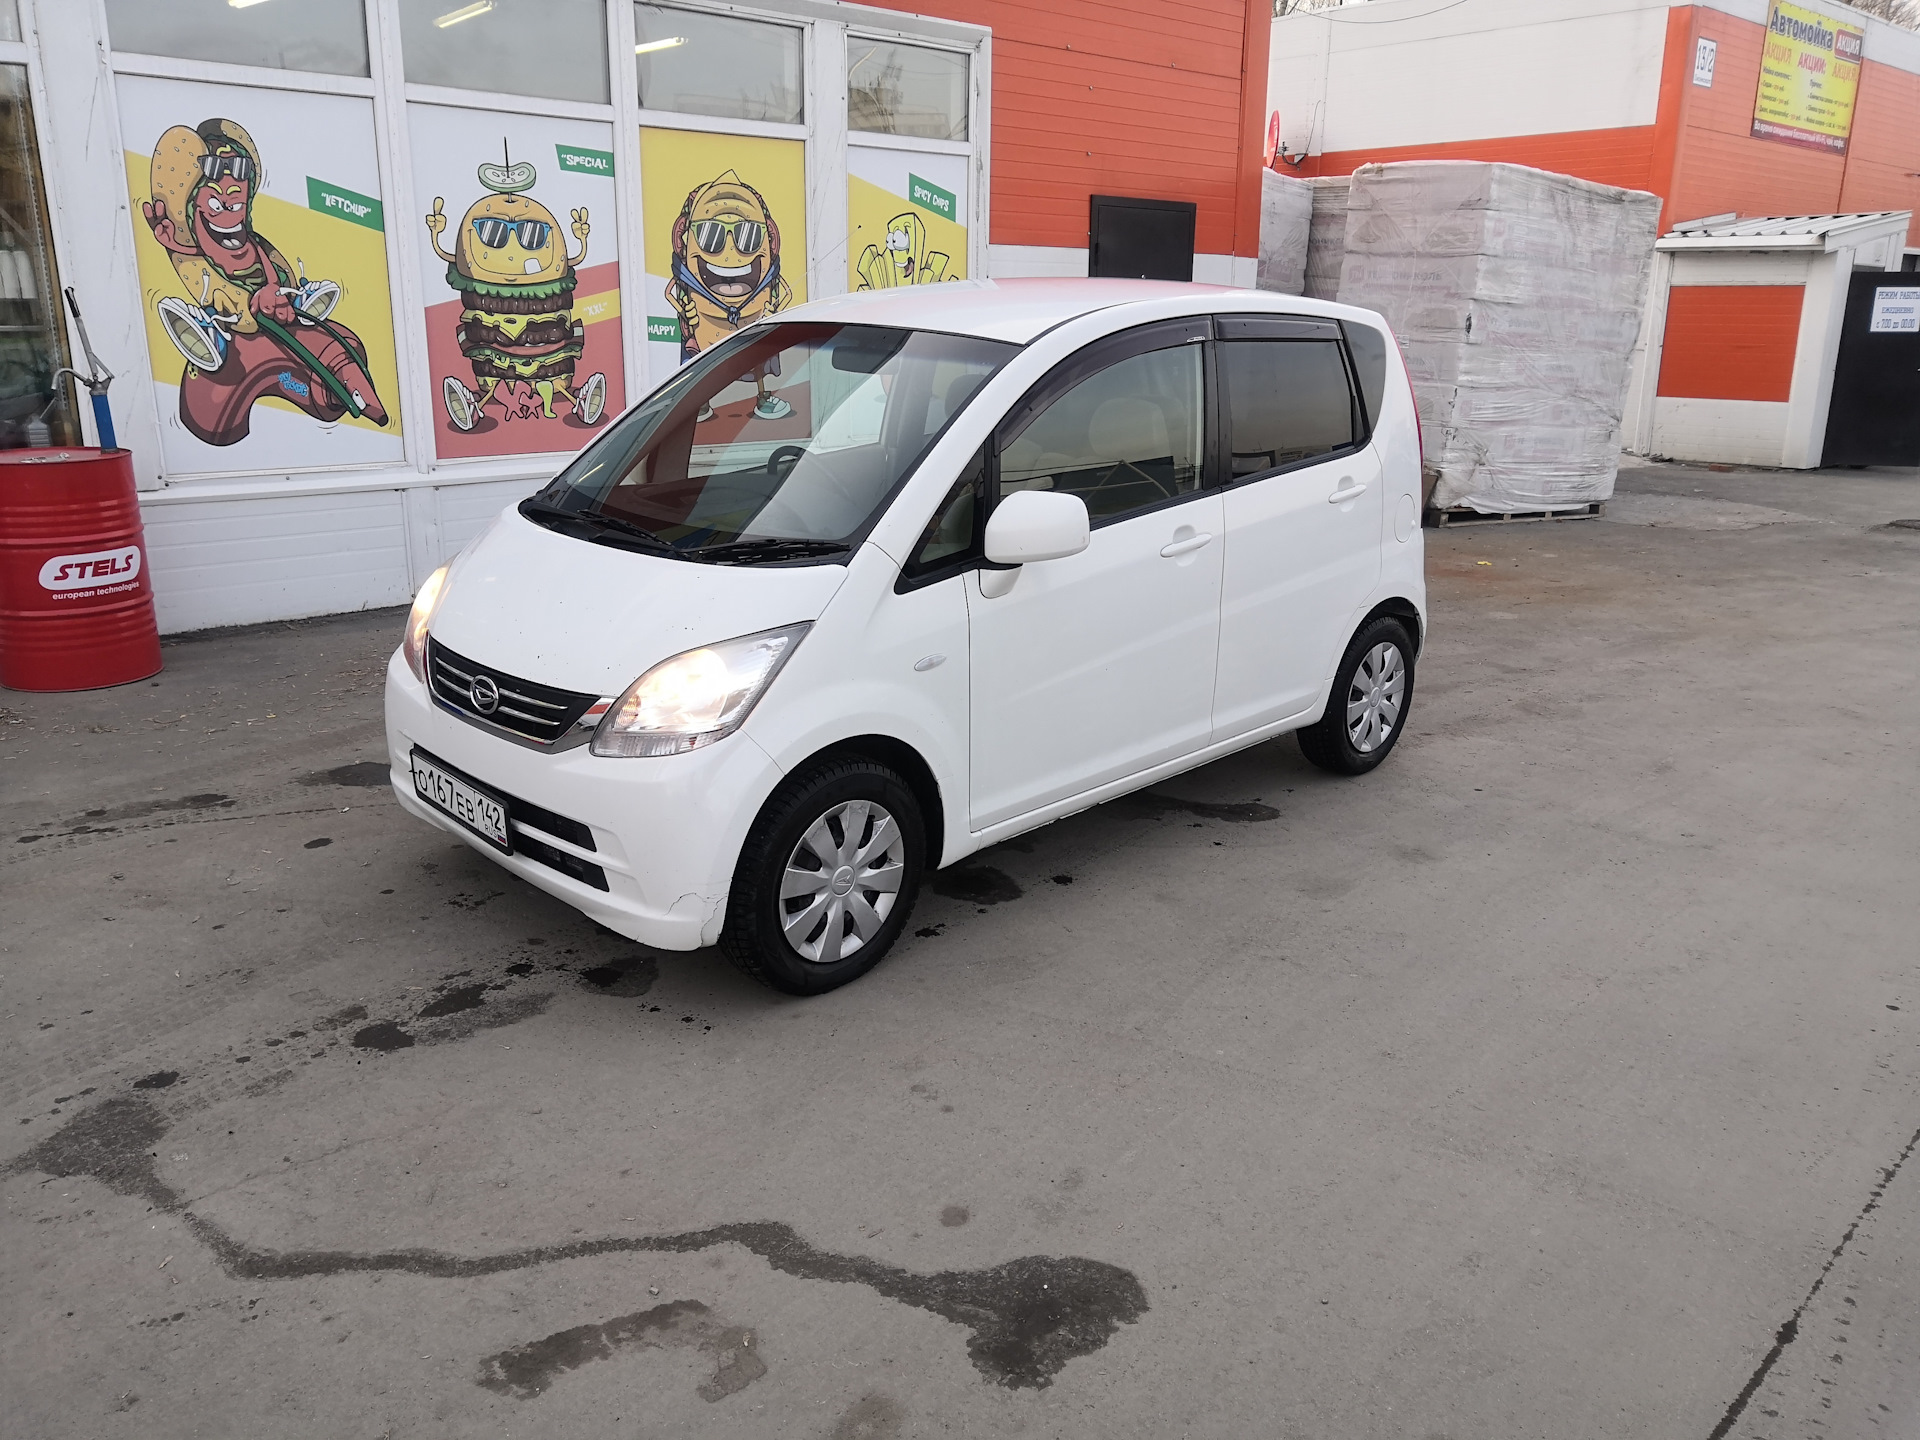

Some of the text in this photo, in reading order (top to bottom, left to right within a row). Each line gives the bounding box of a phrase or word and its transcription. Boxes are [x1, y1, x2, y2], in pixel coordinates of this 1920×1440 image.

[1769, 6, 1834, 51] Автомойка
[1836, 34, 1860, 56] АКЦИЯ
[913, 185, 932, 204] SPICY
[648, 324, 675, 336] HAPPY
[53, 553, 134, 581] STELS
[52, 580, 140, 600] european technologies
[484, 823, 498, 838] RUS
